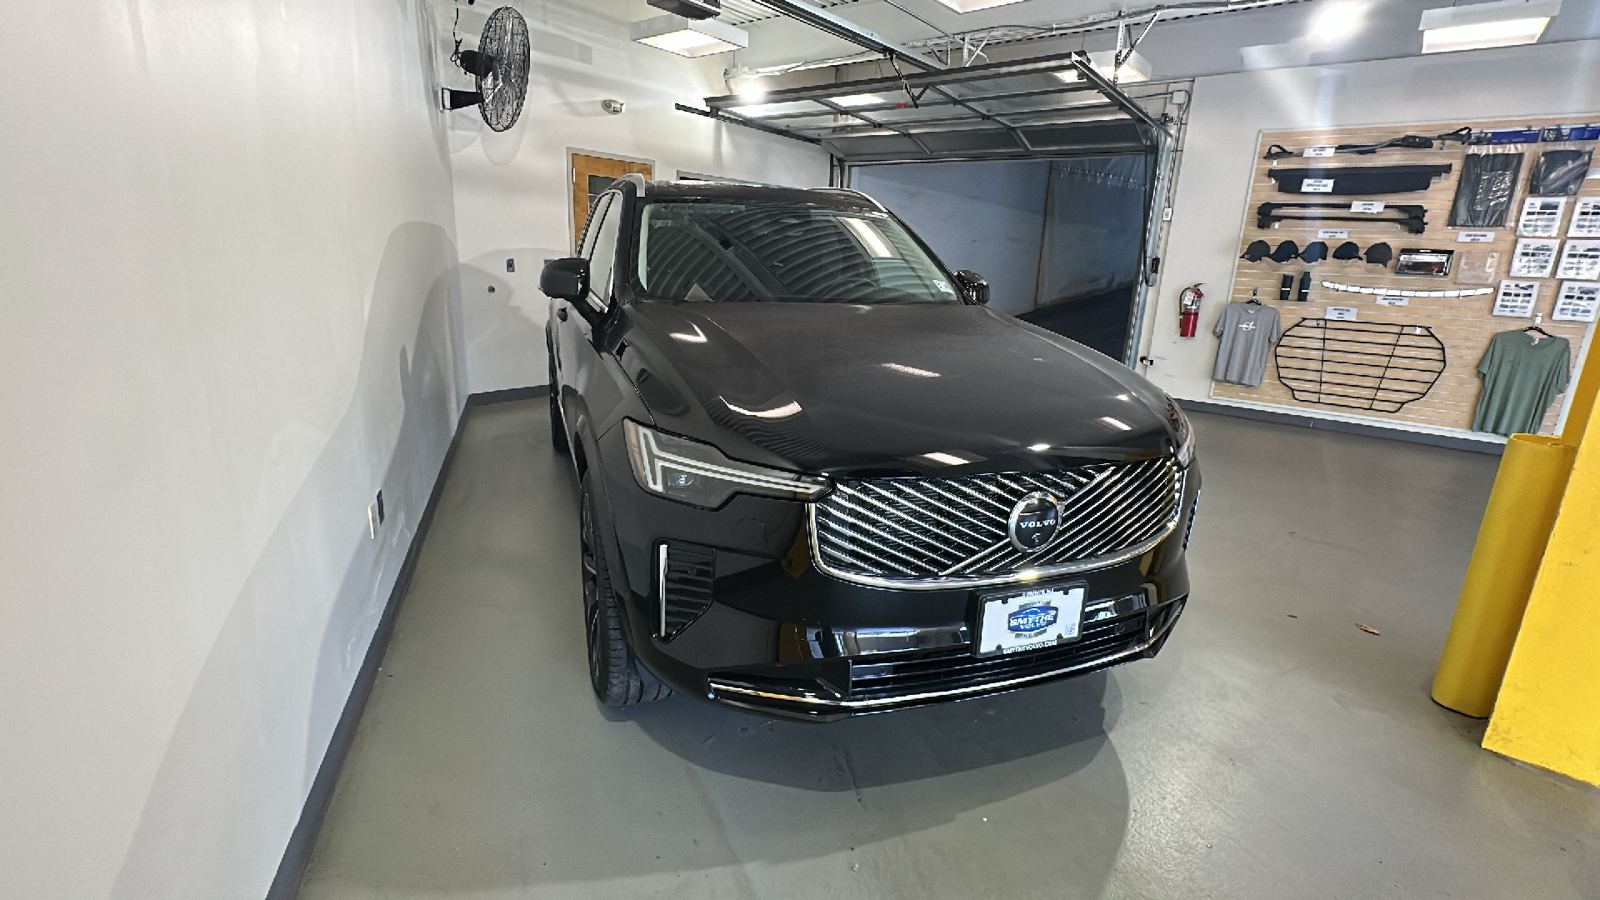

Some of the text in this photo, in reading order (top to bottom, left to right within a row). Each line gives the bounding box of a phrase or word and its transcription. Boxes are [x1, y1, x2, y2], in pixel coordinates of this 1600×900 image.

[1019, 519, 1055, 528] VOLVO
[1010, 614, 1054, 627] SMYTHE
[1019, 621, 1047, 630] VOLVO
